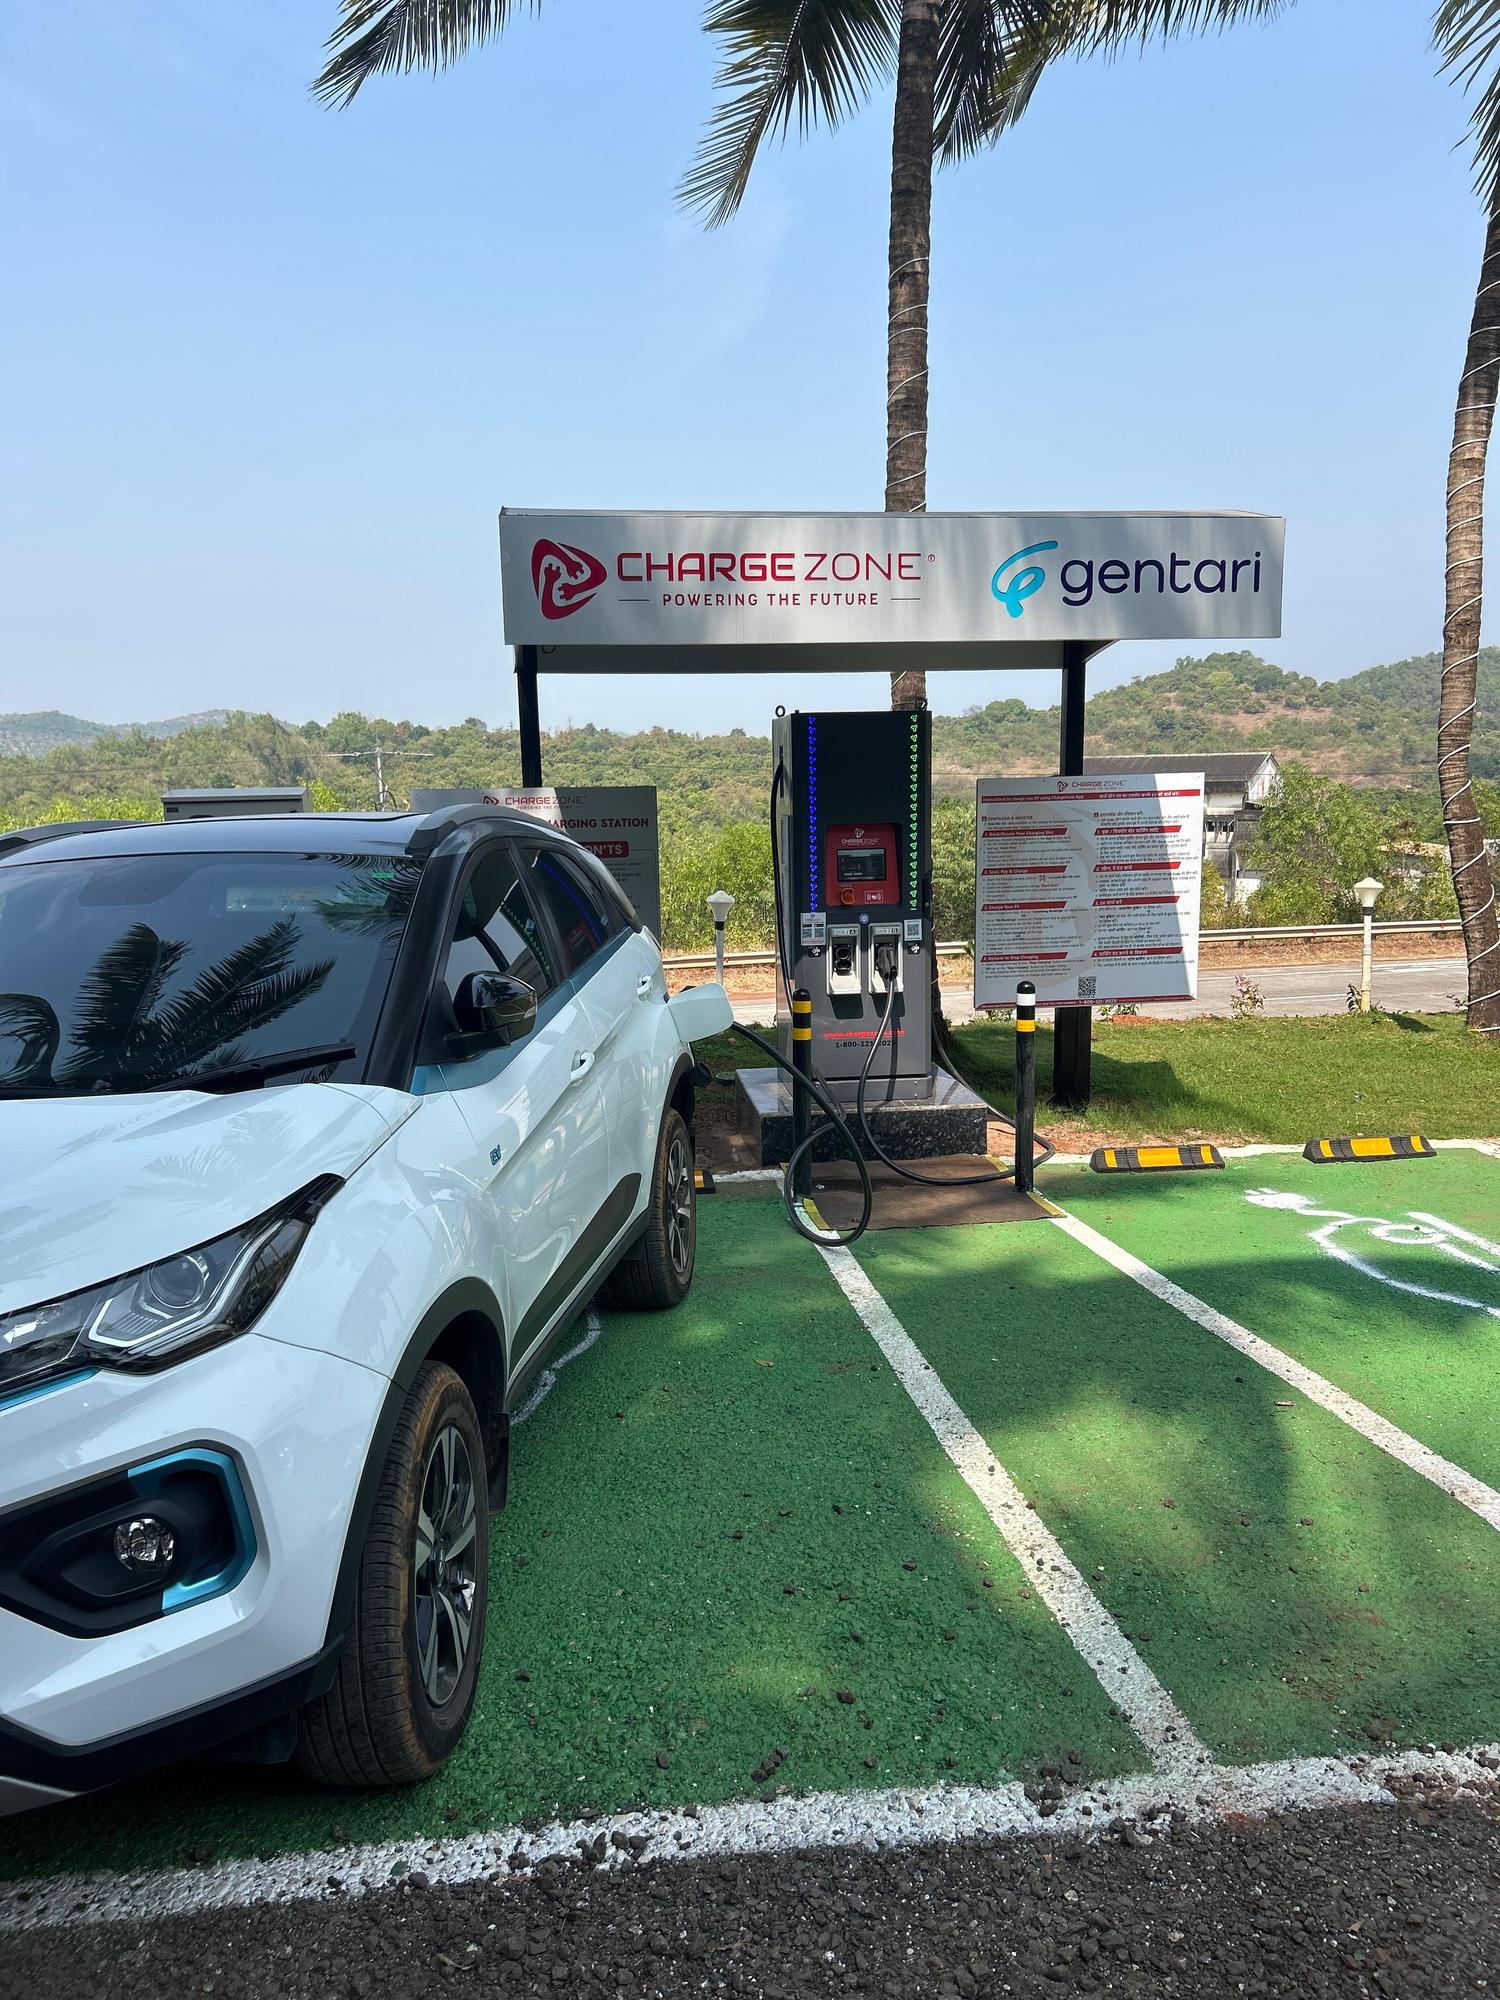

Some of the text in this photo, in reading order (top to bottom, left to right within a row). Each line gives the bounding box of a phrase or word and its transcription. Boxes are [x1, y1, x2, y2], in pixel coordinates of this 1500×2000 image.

[1060, 551, 1261, 607] gentari
[662, 592, 880, 607] POWERING THE FUTURE
[601, 817, 649, 828] STATION
[584, 844, 623, 856] ON'TS
